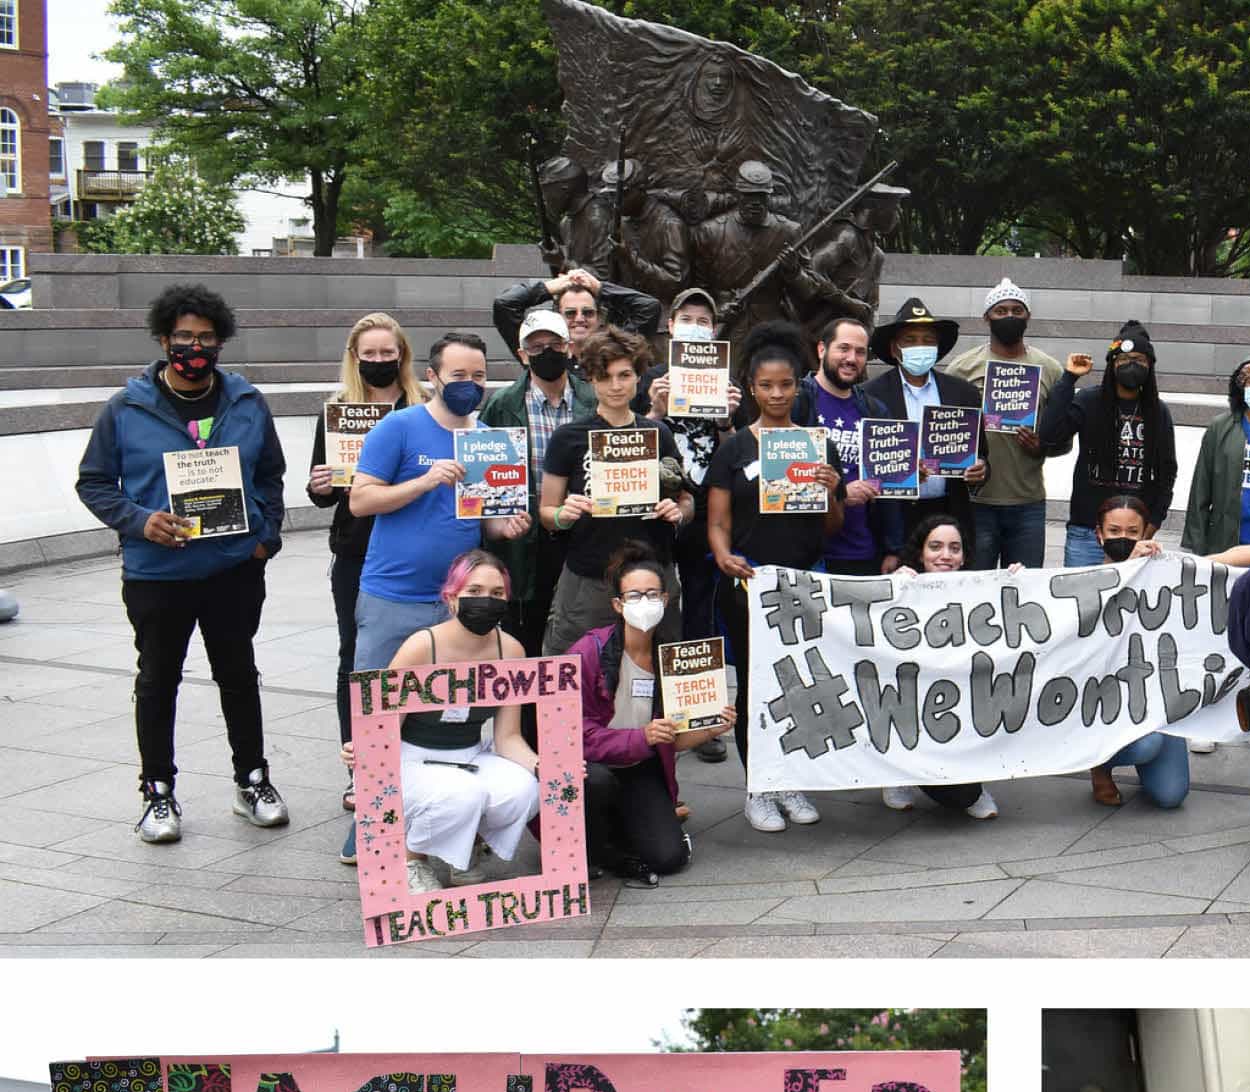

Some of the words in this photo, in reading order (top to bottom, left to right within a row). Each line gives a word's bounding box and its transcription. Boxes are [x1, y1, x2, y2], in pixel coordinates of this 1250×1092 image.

[681, 343, 717, 354] Teach
[681, 354, 719, 365] Power
[995, 366, 1026, 376] Teach
[681, 374, 718, 384] TEACH
[681, 385, 718, 395] TRUTH
[991, 389, 1032, 401] Change
[339, 406, 380, 417] Teach
[995, 401, 1029, 411] Future
[931, 408, 964, 420] Teach
[338, 418, 376, 429] Powe
[870, 422, 904, 437] Teach
[604, 432, 644, 445] Teach
[928, 432, 971, 445] Change
[470, 440, 507, 452] pledge
[603, 445, 647, 457] Power
[773, 440, 808, 450] pledge
[933, 444, 969, 456] Future
[463, 454, 475, 462] to
[478, 453, 508, 462] Teach
[767, 451, 778, 460] to
[780, 450, 808, 460] Teach
[869, 449, 912, 464] Change
[194, 459, 216, 468] truth
[874, 462, 910, 476] Future
[491, 470, 519, 480] Truth
[604, 467, 648, 479] TEACH
[605, 481, 648, 493] TRUTH
[672, 641, 711, 658] Teach
[673, 656, 713, 671] Power
[674, 677, 716, 693] TEACH
[676, 691, 717, 707] TRUTH
[366, 898, 470, 946] TEACH
[477, 883, 588, 929] TRUTH
